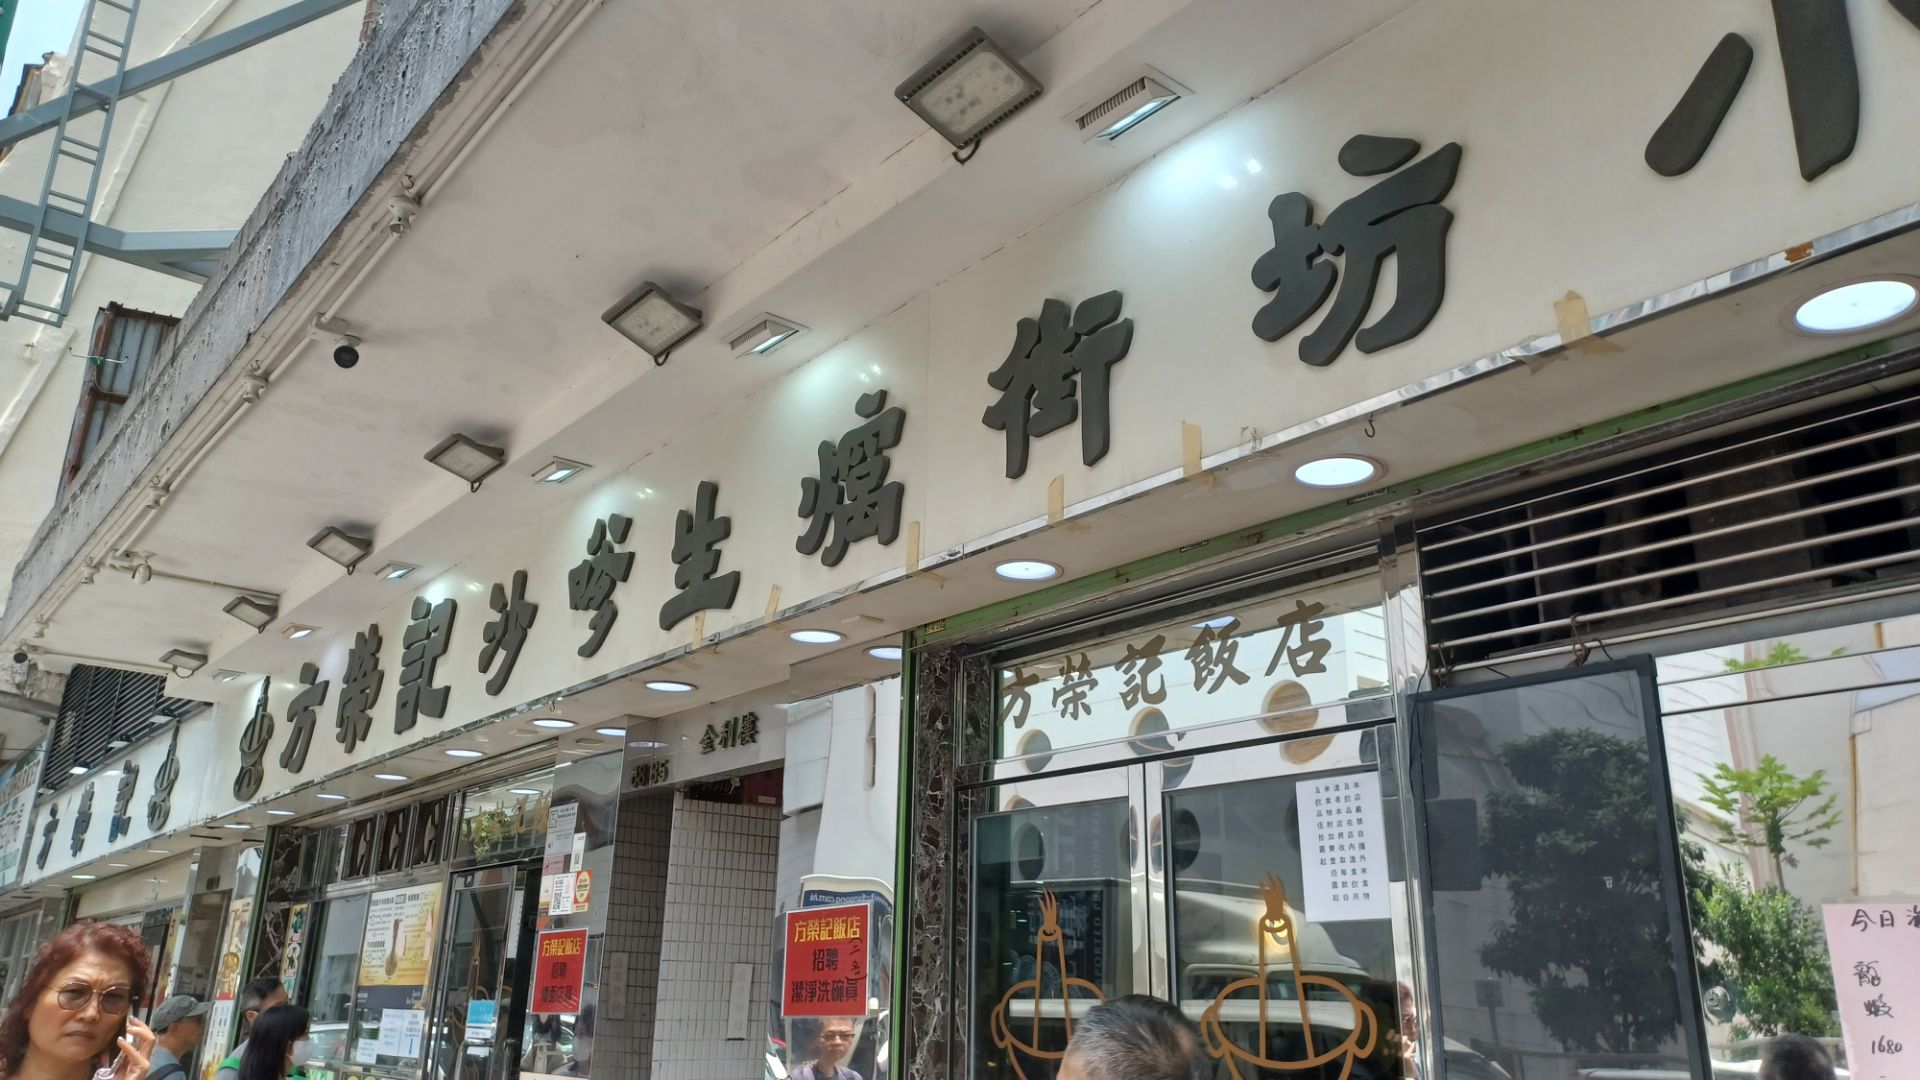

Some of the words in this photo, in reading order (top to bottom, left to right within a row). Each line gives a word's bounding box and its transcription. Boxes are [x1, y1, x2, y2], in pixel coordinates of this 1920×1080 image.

[999, 600, 1332, 728] 方榮記飯店
[699, 712, 760, 755] 金利樓
[794, 916, 860, 943] 方榮記飯店
[542, 937, 581, 957] 方榮記飯店
[812, 948, 838, 971] 招聘
[1871, 1035, 1903, 1054] 1680
